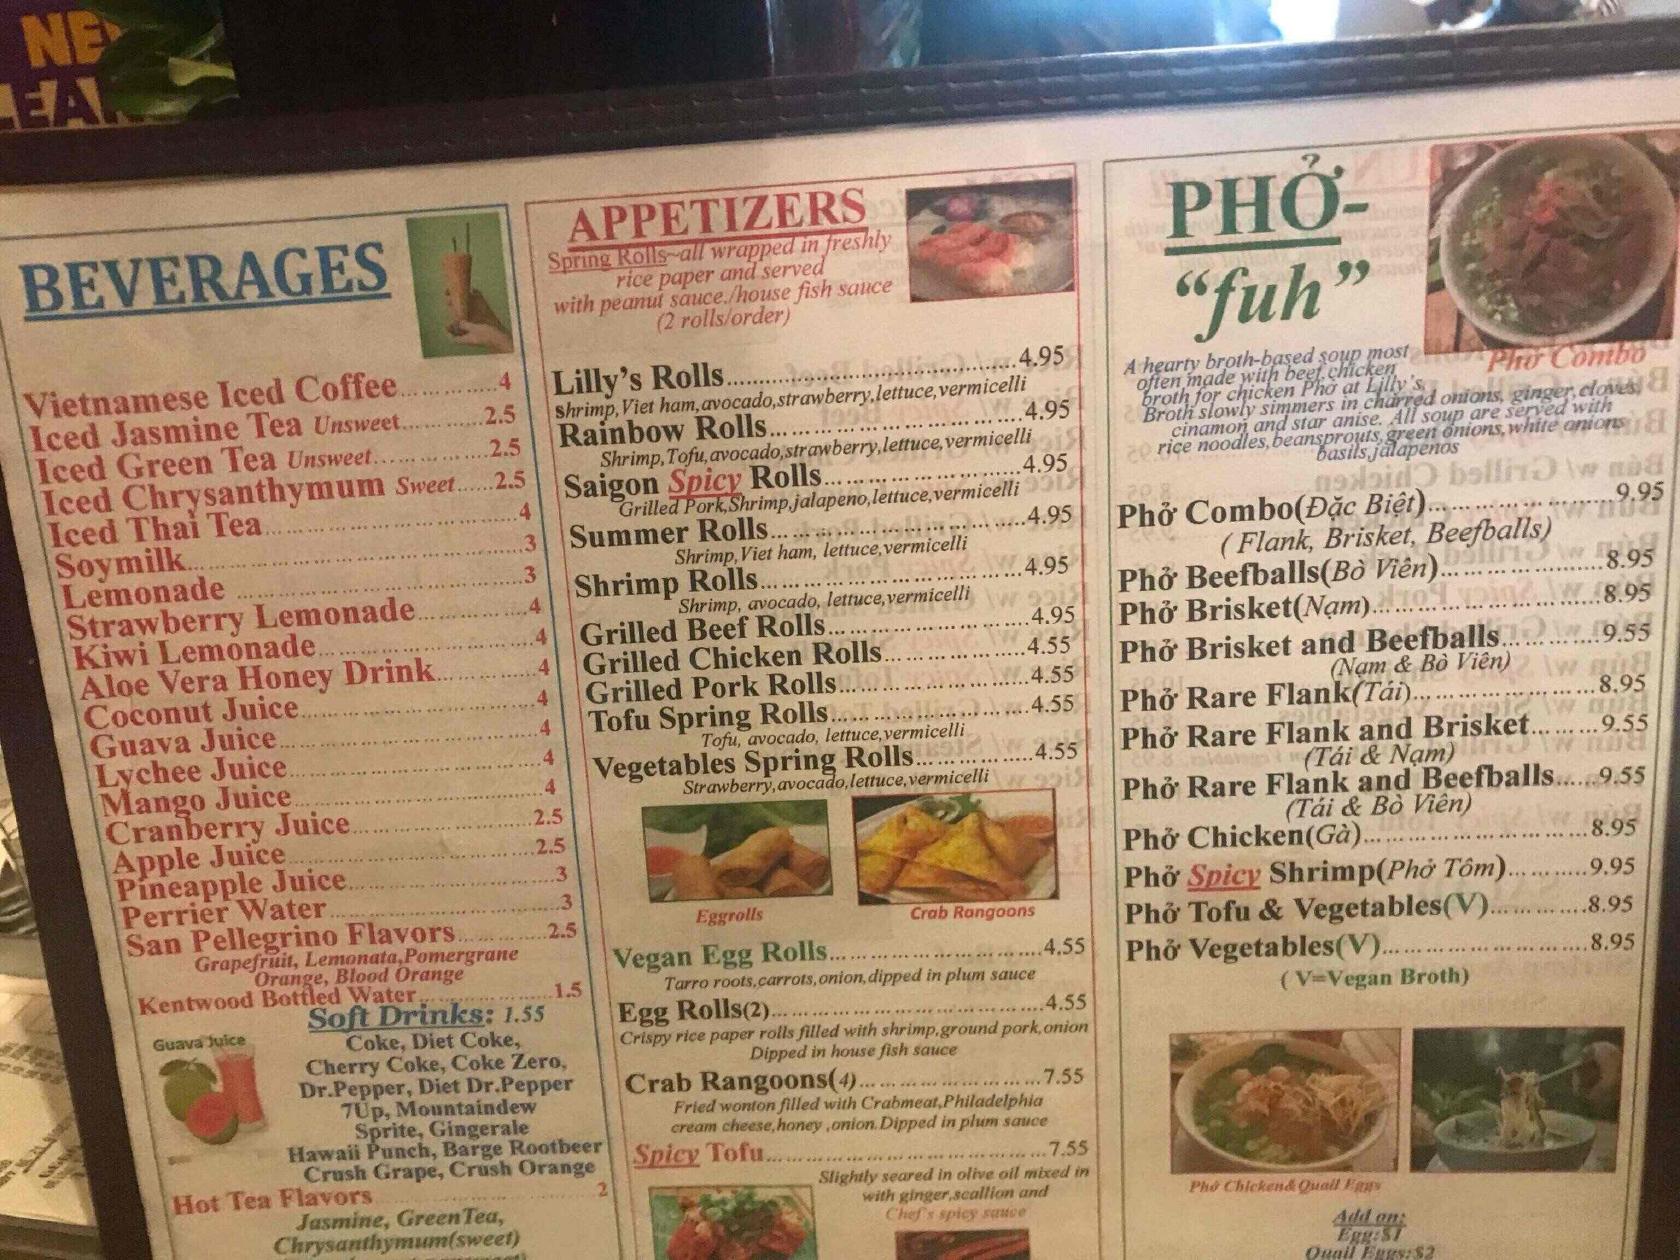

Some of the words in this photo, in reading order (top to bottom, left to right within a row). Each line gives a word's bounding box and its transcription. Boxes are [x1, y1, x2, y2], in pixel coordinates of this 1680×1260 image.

[568, 188, 869, 251] APPETIZERS
[710, 237, 795, 263] wrapped
[800, 236, 819, 254] in
[825, 231, 892, 258] freshly
[19, 241, 391, 320] BEVERAGES
[616, 270, 653, 289] rice
[659, 268, 715, 292] paper
[720, 263, 756, 282] and
[761, 258, 824, 279] served
[652, 363, 724, 391] Rolls
[1018, 346, 1065, 367] 4.95
[1124, 359, 1137, 376] A
[1142, 355, 1201, 377] hearty
[1205, 349, 1315, 371] broth-based
[1319, 349, 1362, 369] soup
[1366, 346, 1408, 364] most
[24, 391, 208, 419] Vietnamese
[217, 377, 284, 408] Iced
[294, 372, 397, 403] Coffee
[500, 373, 512, 391] 4
[30, 422, 100, 452] Iced
[111, 416, 239, 448] Jasmine
[246, 411, 303, 440] Tea
[314, 413, 400, 436] Unsweet
[484, 405, 516, 424] 2.5
[559, 419, 685, 448] Rainbow
[696, 415, 767, 440] Rolls
[1024, 400, 1070, 421] 4.95
[42, 488, 112, 516] Iced
[122, 474, 386, 513] Chrysanthymum
[396, 475, 456, 495] Sweet
[495, 471, 526, 490] 2.5
[564, 473, 659, 503] Saigon
[667, 468, 743, 498] Spicy
[750, 463, 821, 489] Rolls
[1024, 454, 1068, 475] 4.95
[48, 519, 117, 548] Iced
[127, 515, 198, 543] Thai
[207, 511, 262, 538] Tea
[569, 522, 690, 549] Summer
[698, 519, 768, 543] Rolls
[1027, 505, 1073, 525] 4.95
[1237, 531, 1314, 555] Flank,
[1324, 523, 1417, 550] Brisket,
[1426, 516, 1553, 546] Beefballs)
[54, 548, 187, 582] Soymilk
[574, 571, 679, 600] Shrimp
[688, 568, 758, 593] Rolls
[1024, 557, 1069, 577] 4.95
[61, 578, 225, 609] Lemonade
[66, 609, 244, 642] Strawberry
[255, 598, 415, 629] Lemonade
[579, 617, 677, 646] Grilled
[687, 616, 747, 641] Beef
[757, 614, 825, 637] Rolls
[1032, 606, 1076, 626] 4.95
[583, 647, 680, 676] Grilled
[689, 644, 802, 670] Chicken
[813, 641, 881, 665] Rolls
[1027, 637, 1072, 655] 4.55
[1185, 630, 1293, 661] Brisket
[1301, 629, 1356, 655] and
[1366, 627, 1500, 652] Beefballs
[1602, 623, 1651, 643] 9.55
[80, 669, 151, 701] Aloe
[158, 669, 228, 695] Vera
[238, 664, 333, 694] Honey
[345, 658, 436, 686] Drink
[84, 701, 214, 730] Coconut
[222, 696, 299, 722] Juice
[587, 706, 651, 734] Tofu
[659, 704, 752, 732] Spring
[761, 700, 829, 724] Rolls
[1186, 721, 1257, 748] Rare
[1265, 718, 1349, 745] Flank
[1358, 716, 1413, 743] and
[1423, 714, 1529, 738] Brisket
[1601, 715, 1649, 734] 9.55
[593, 749, 735, 783] Vegetables
[744, 749, 836, 777] Spring
[845, 744, 914, 769] Rolls
[101, 790, 205, 818] Mango
[215, 787, 292, 811] Juice
[106, 816, 264, 846] Cranberry
[275, 813, 351, 837] Juice
[534, 809, 563, 826] 2.5
[113, 847, 202, 878] Apple
[210, 843, 286, 868] Juice
[1186, 863, 1261, 892] Spicy
[1589, 857, 1636, 876] 9.95
[116, 873, 263, 902] Pineapple
[272, 872, 346, 894] Juice
[121, 902, 229, 929] Perrier
[240, 900, 327, 923] Water
[696, 906, 763, 925] Eggrolls
[910, 905, 950, 921] Crab
[955, 904, 1036, 922] Rangoons
[1187, 898, 1250, 923] Tofu
[1259, 900, 1283, 921] &
[1588, 894, 1633, 914] 8.95
[126, 934, 182, 959] San
[191, 927, 338, 955] Pellegrino
[346, 922, 455, 946] Flavors
[548, 923, 578, 940] 2.5
[613, 947, 692, 974] Vegan
[702, 943, 753, 969] Egg
[761, 940, 827, 963] Rolls
[1043, 937, 1085, 956] 4.55
[1401, 966, 1470, 987] Broth)
[308, 1005, 370, 1032] Soft
[379, 1003, 494, 1027] Drinks:
[503, 1005, 546, 1023] 1.55
[153, 1036, 203, 1052] Guava
[209, 1034, 246, 1048] Juice
[750, 1045, 808, 1062] Dipped
[812, 1044, 827, 1059] in
[831, 1043, 875, 1059] house
[879, 1040, 910, 1060] fish
[913, 1043, 957, 1056] sauce
[306, 1057, 380, 1079] Cherry
[387, 1056, 445, 1075] Coke,
[451, 1054, 505, 1071] Coke
[511, 1053, 567, 1071] Zero,
[625, 1071, 692, 1095] Crab
[1042, 1067, 1085, 1085] 7.55
[341, 1103, 392, 1123] 7Up,
[397, 1099, 536, 1118] Mountaindew
[356, 1121, 423, 1142] Sprite,
[429, 1120, 529, 1140] Gingerale
[633, 1142, 701, 1169] Spicy
[707, 1140, 764, 1164] Tofu
[1048, 1140, 1089, 1158] 7.55
[819, 1166, 877, 1185] Slightly
[881, 1165, 935, 1181] seared
[939, 1164, 953, 1180] in
[173, 1195, 218, 1216] Hot
[227, 1191, 271, 1212] Tea
[281, 1188, 372, 1209] Flavors
